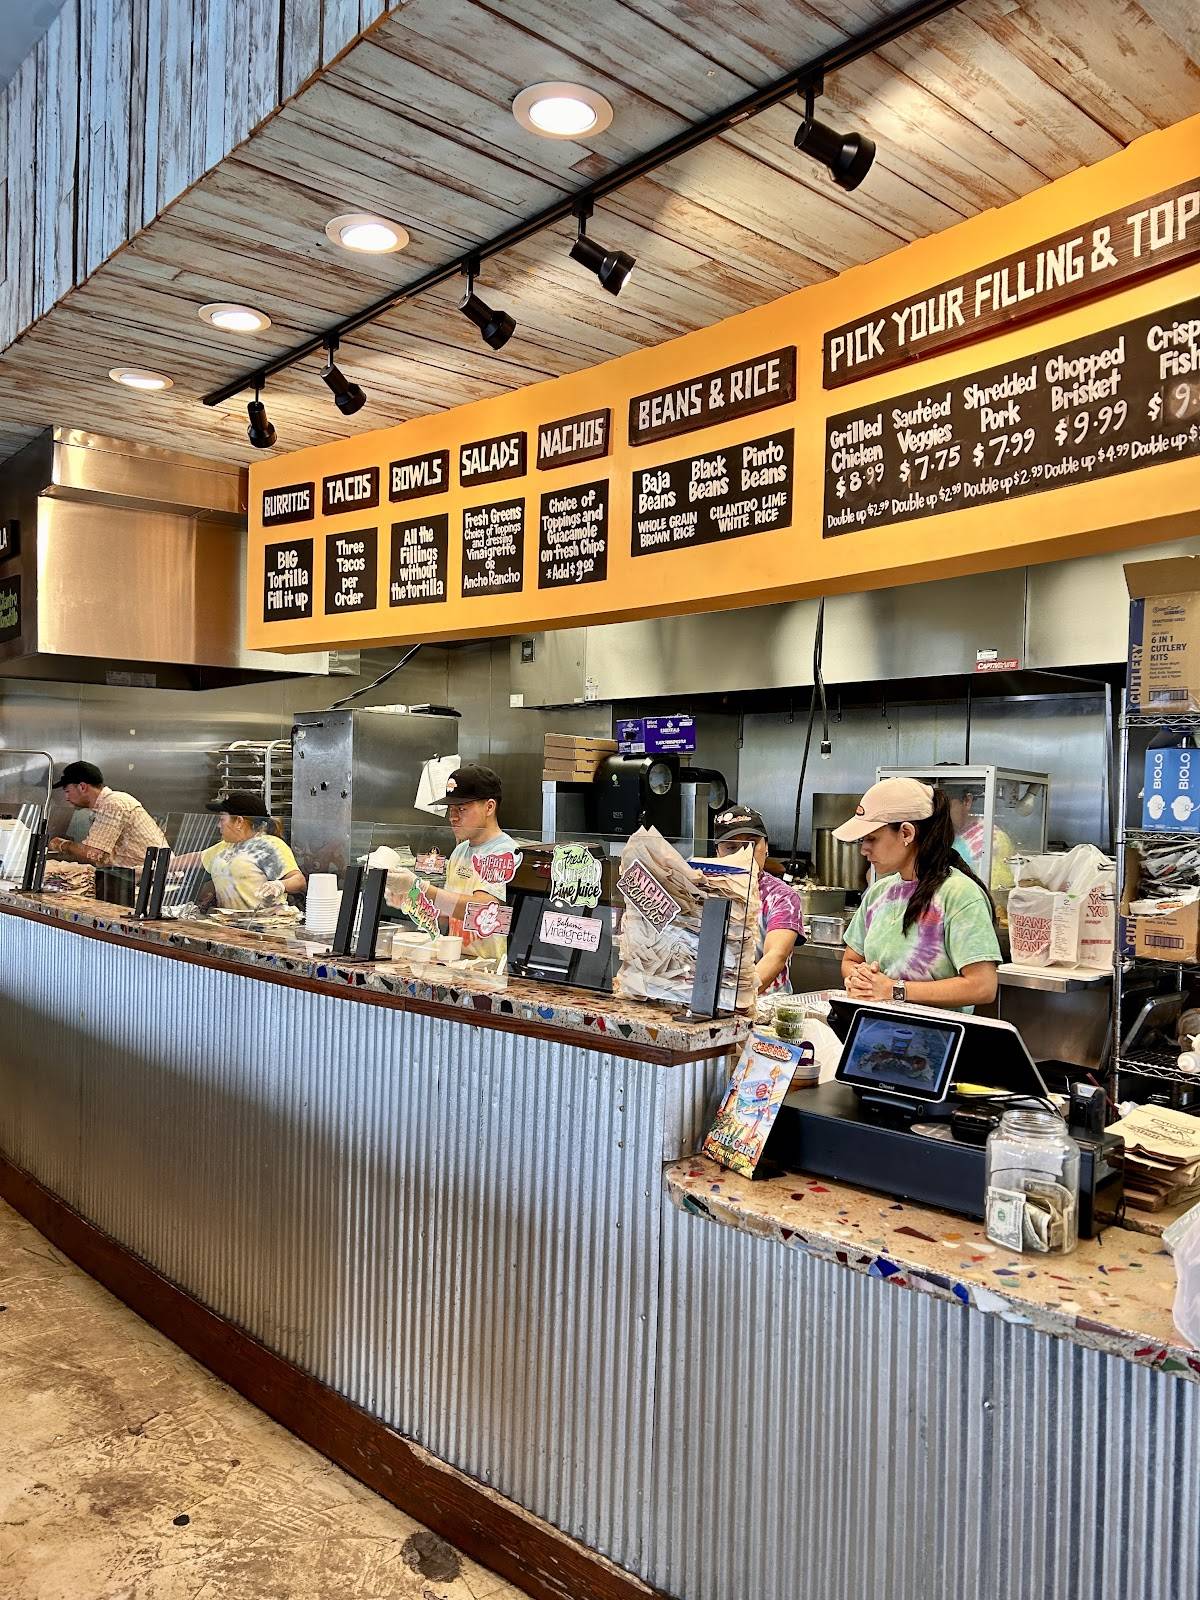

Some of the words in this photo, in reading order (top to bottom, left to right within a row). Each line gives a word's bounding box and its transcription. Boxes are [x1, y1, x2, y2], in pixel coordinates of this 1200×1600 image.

[830, 318, 886, 373] PICK
[891, 286, 966, 347] YOUR
[974, 236, 1085, 318] FILLING
[1091, 226, 1119, 273] &
[1126, 191, 1200, 257] TOP
[1045, 335, 1125, 383] Chopped
[638, 383, 702, 430] BEANS
[708, 377, 725, 410] &
[730, 358, 780, 403] RICE
[963, 365, 1037, 410] Shredded
[1051, 367, 1122, 412] Brisket
[980, 399, 1021, 433] Pork
[540, 417, 604, 459] NACHOS
[830, 413, 882, 449] Grilled
[896, 422, 952, 454] Veggies
[461, 438, 519, 477] SALADS
[742, 440, 784, 468] Pinto
[831, 443, 883, 474] Chicken
[392, 458, 442, 492] BOWLS
[691, 455, 728, 482] Black
[741, 464, 788, 491] Beans
[827, 507, 855, 529] Double
[856, 508, 867, 525] up
[892, 491, 925, 515] Double
[926, 493, 938, 509] up
[963, 477, 999, 498] Double
[1000, 475, 1013, 494] up
[1044, 455, 1079, 479] Double
[1081, 454, 1096, 472] up
[1131, 433, 1169, 460] Double
[1170, 433, 1188, 451] up
[326, 473, 372, 504] TACOS
[642, 470, 671, 495] Baja
[688, 476, 730, 502] Beans
[264, 489, 310, 518] BURRITOS
[548, 497, 578, 514] Choice
[581, 489, 596, 507] of
[638, 490, 677, 515] Beans
[709, 499, 759, 521] CILANTRO
[761, 491, 788, 508] LIME
[464, 508, 489, 529] Fresh
[490, 506, 523, 524] Greens
[541, 513, 582, 535] Toppings
[582, 503, 604, 522] and
[637, 519, 668, 535] WHOLE
[668, 511, 698, 530] GRAIN
[717, 513, 750, 534] WHITE
[754, 507, 780, 526] RICE
[403, 527, 418, 546] All
[418, 525, 434, 544] the
[464, 526, 486, 541] Choice
[486, 526, 495, 537] of
[494, 522, 522, 537] Toppings
[471, 537, 485, 549] and
[485, 534, 514, 548] dressing
[546, 524, 599, 545] Guacamole
[640, 531, 671, 549] BROWN
[673, 524, 696, 541] RICE
[277, 549, 298, 570] BIG
[336, 540, 365, 556] Three
[399, 545, 438, 566] Fillings
[466, 543, 517, 562] Vinaigrette
[540, 549, 554, 563] on
[553, 541, 580, 560] fresh
[580, 538, 606, 558] Chips
[336, 557, 366, 573] Tacos
[400, 561, 438, 582] without
[267, 568, 309, 589] Tortilla
[341, 576, 359, 593] per
[391, 582, 407, 600] the
[406, 577, 444, 599] tortilla
[463, 572, 489, 590] Ancho
[488, 567, 521, 586] Rancho
[267, 590, 284, 610] Fill
[284, 589, 294, 608] it
[294, 592, 309, 612] up
[334, 589, 364, 607] Order
[1150, 653, 1169, 661] KITS
[1151, 643, 1187, 653] CUTLERY
[1153, 754, 1163, 789] BIOLO
[1179, 753, 1191, 790] BIOLO
[564, 850, 590, 869] Fresh
[632, 867, 670, 915] ANCHO
[544, 919, 597, 944] Vinaigrette
